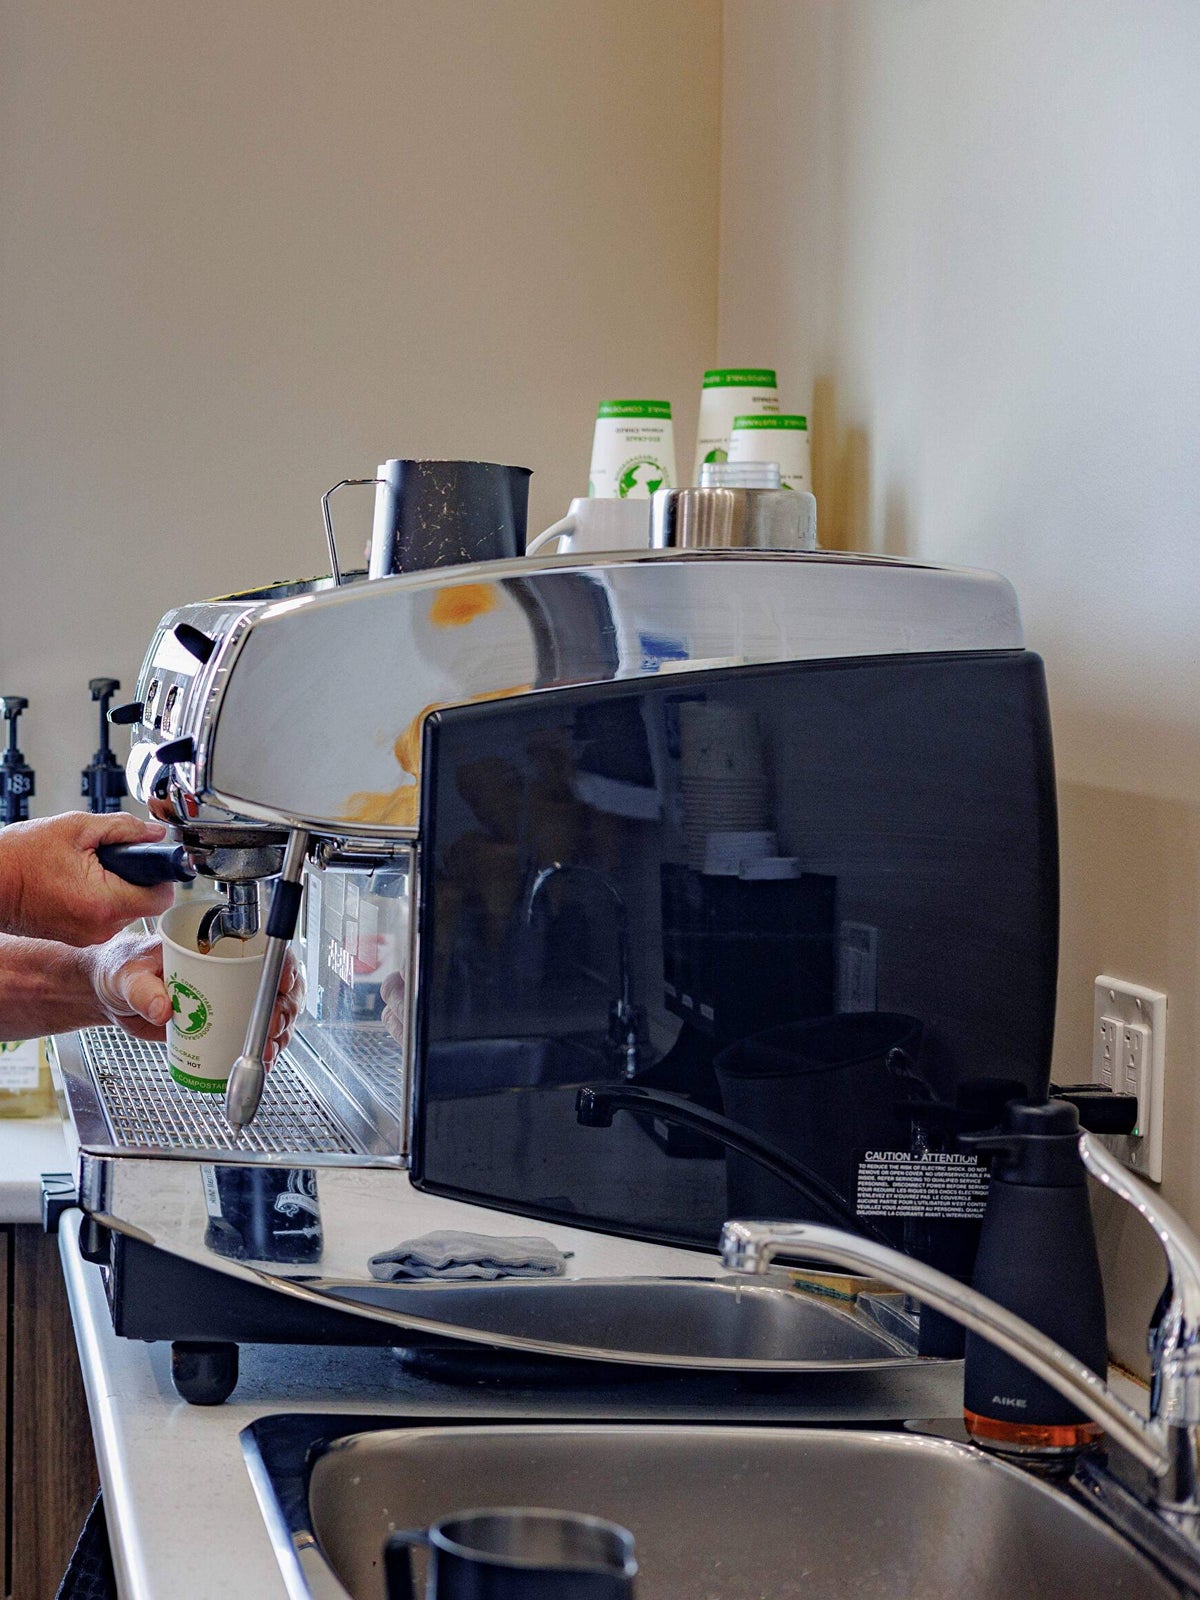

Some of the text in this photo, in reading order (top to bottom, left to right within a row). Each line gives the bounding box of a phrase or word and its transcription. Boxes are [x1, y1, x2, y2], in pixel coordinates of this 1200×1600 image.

[187, 1061, 202, 1069] HOT
[865, 1151, 978, 1163] CAUTION ATTENTION
[992, 1395, 1027, 1409] AIKE
